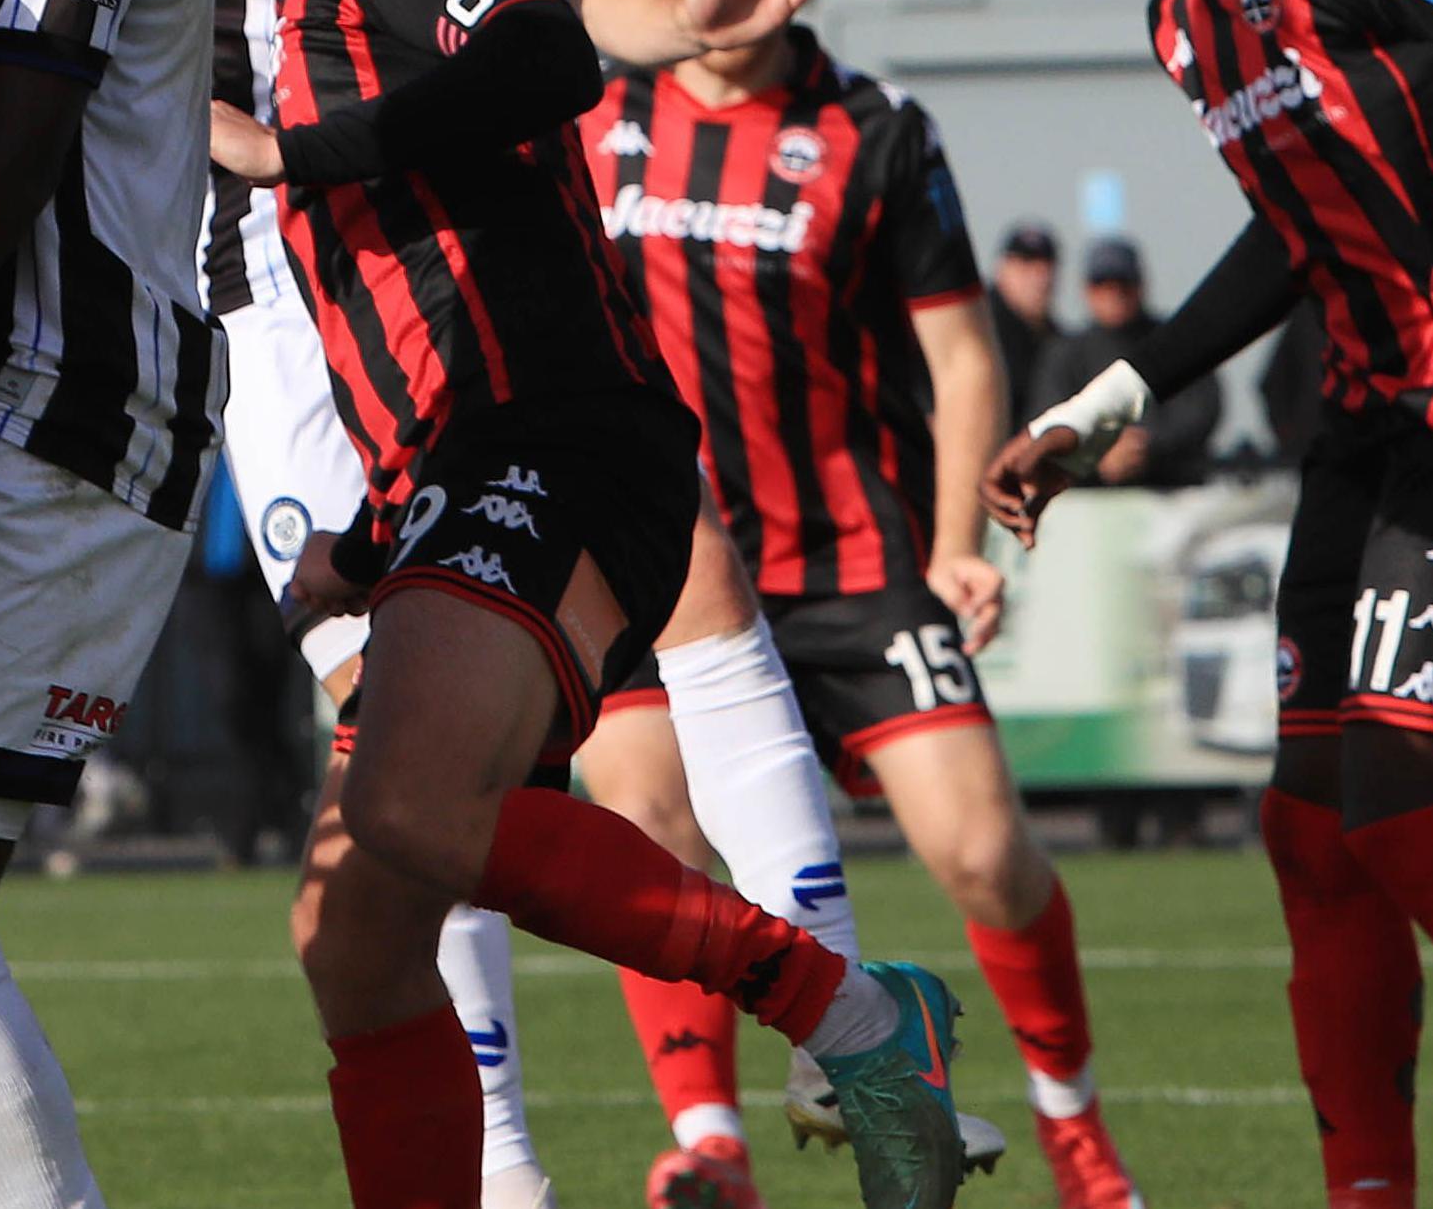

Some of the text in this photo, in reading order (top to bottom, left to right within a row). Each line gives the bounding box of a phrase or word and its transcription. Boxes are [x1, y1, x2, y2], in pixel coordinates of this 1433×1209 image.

[601, 183, 815, 254] Jacuzzi
[884, 623, 977, 713] 15
[1349, 587, 1410, 692] 11
